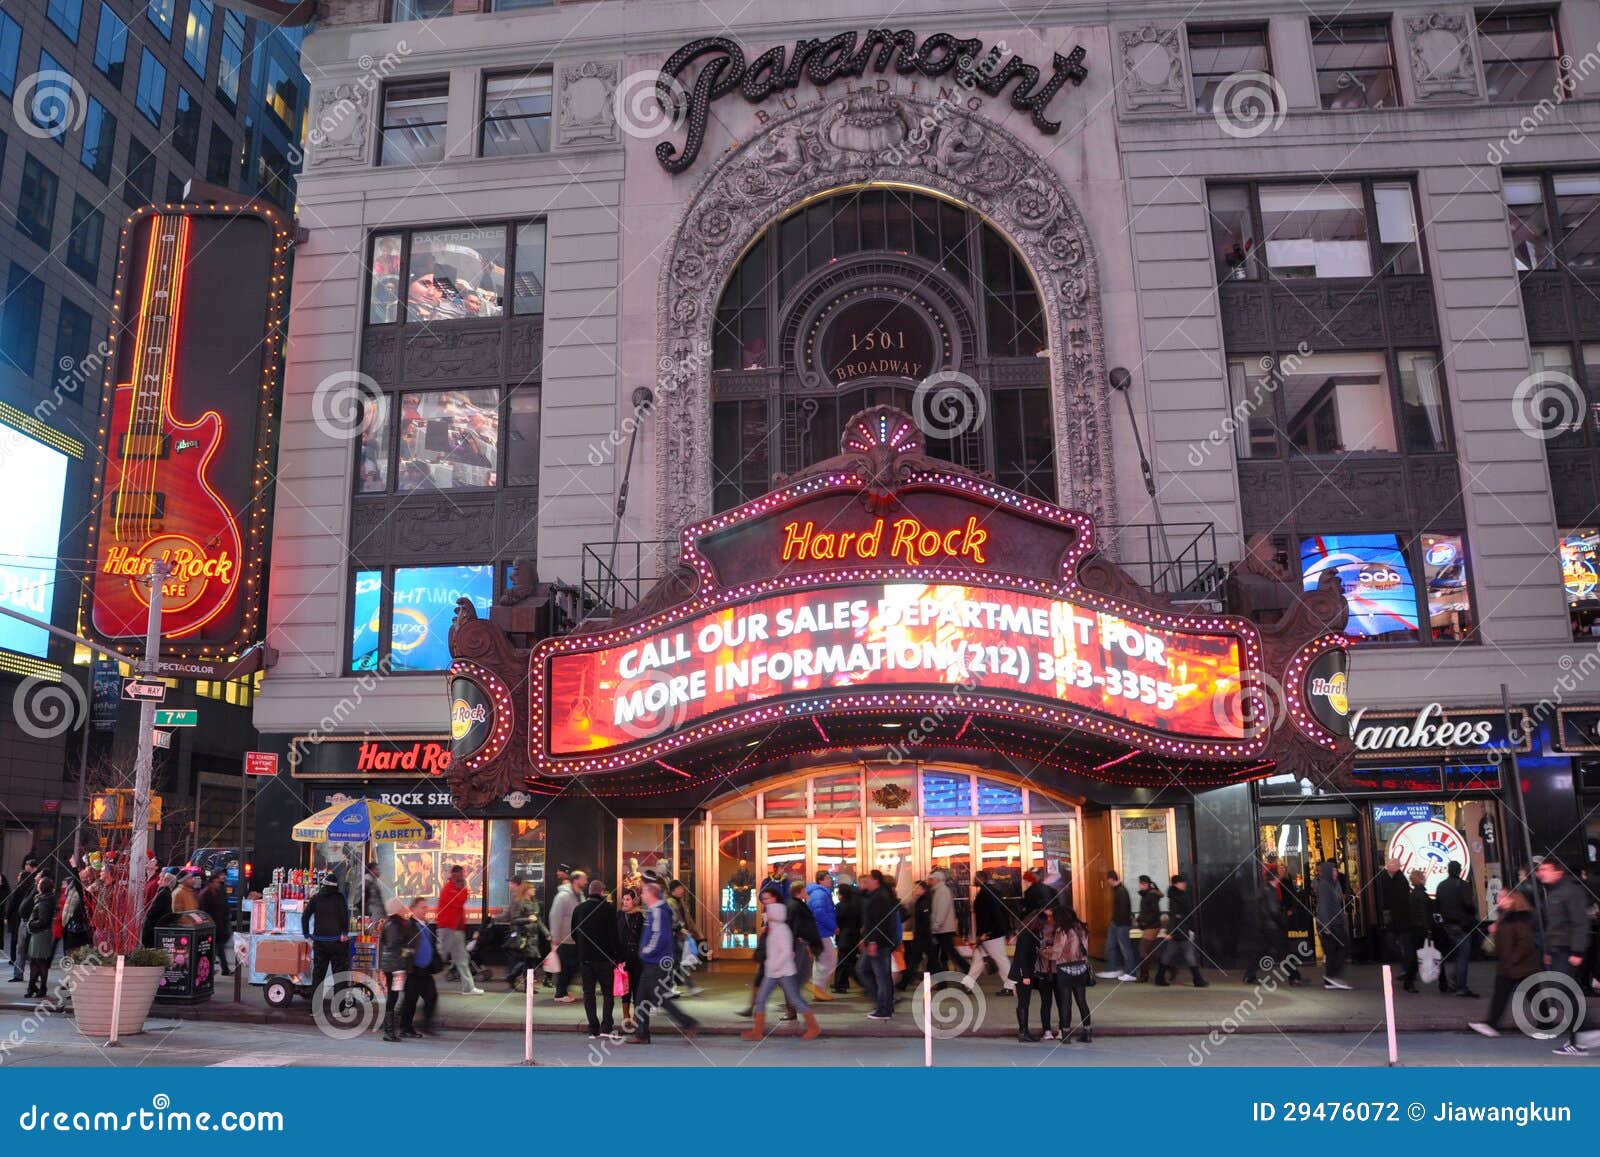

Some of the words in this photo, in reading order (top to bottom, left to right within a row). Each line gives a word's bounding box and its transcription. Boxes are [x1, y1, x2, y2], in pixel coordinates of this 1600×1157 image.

[655, 29, 1089, 174] Paramount
[755, 79, 983, 125] BUILDING
[851, 331, 905, 351] 1501
[836, 359, 922, 380] BROADWAY
[783, 518, 884, 560] Hard
[891, 516, 987, 566] Rock
[171, 548, 232, 584] Rock
[148, 584, 187, 597] AFE
[619, 632, 691, 679] CALL
[698, 613, 768, 653] OUR
[775, 600, 870, 637] SALES
[878, 600, 1094, 646] DEPARTMENT
[1101, 620, 1168, 666] FOR
[158, 662, 214, 674] PECTACOLOR
[130, 685, 142, 694] ONE
[147, 686, 161, 695] WAY
[614, 669, 706, 725] MORE
[950, 640, 1031, 685] (212)
[1038, 651, 1176, 711] 343-3355
[1312, 678, 1342, 696] Hard
[165, 712, 174, 724] 7
[458, 703, 486, 723] Rock
[357, 743, 421, 770] Hard
[421, 743, 453, 776] Ro
[381, 793, 424, 805] ROCK
[428, 793, 453, 805] SH
[375, 828, 423, 840] SABRETT
